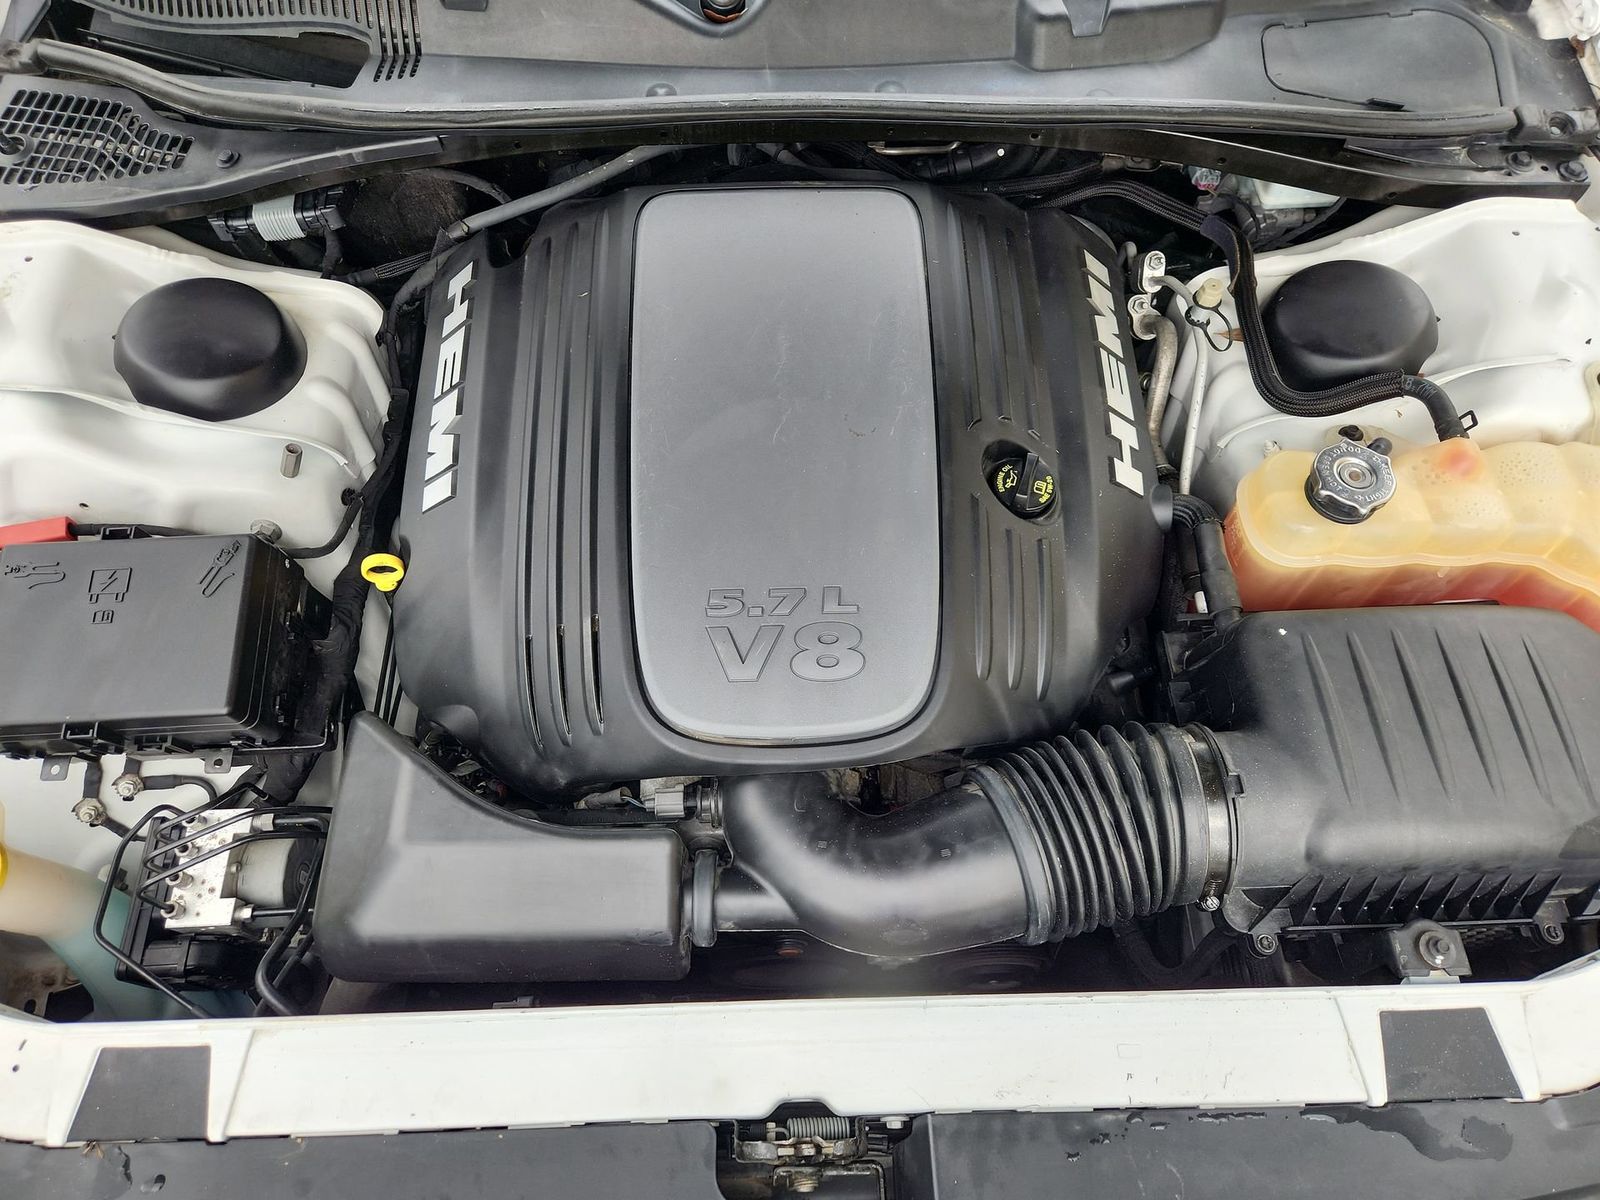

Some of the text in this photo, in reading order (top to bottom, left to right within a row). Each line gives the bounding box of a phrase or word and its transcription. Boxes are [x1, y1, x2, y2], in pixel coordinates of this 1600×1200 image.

[422, 261, 474, 514] HEMI
[1084, 249, 1144, 496] HEMI
[997, 464, 1013, 493] ENGINE OIL
[1366, 463, 1392, 502] KEEP TIGHT
[705, 586, 859, 617] 5.7 L
[705, 621, 866, 682] V8
